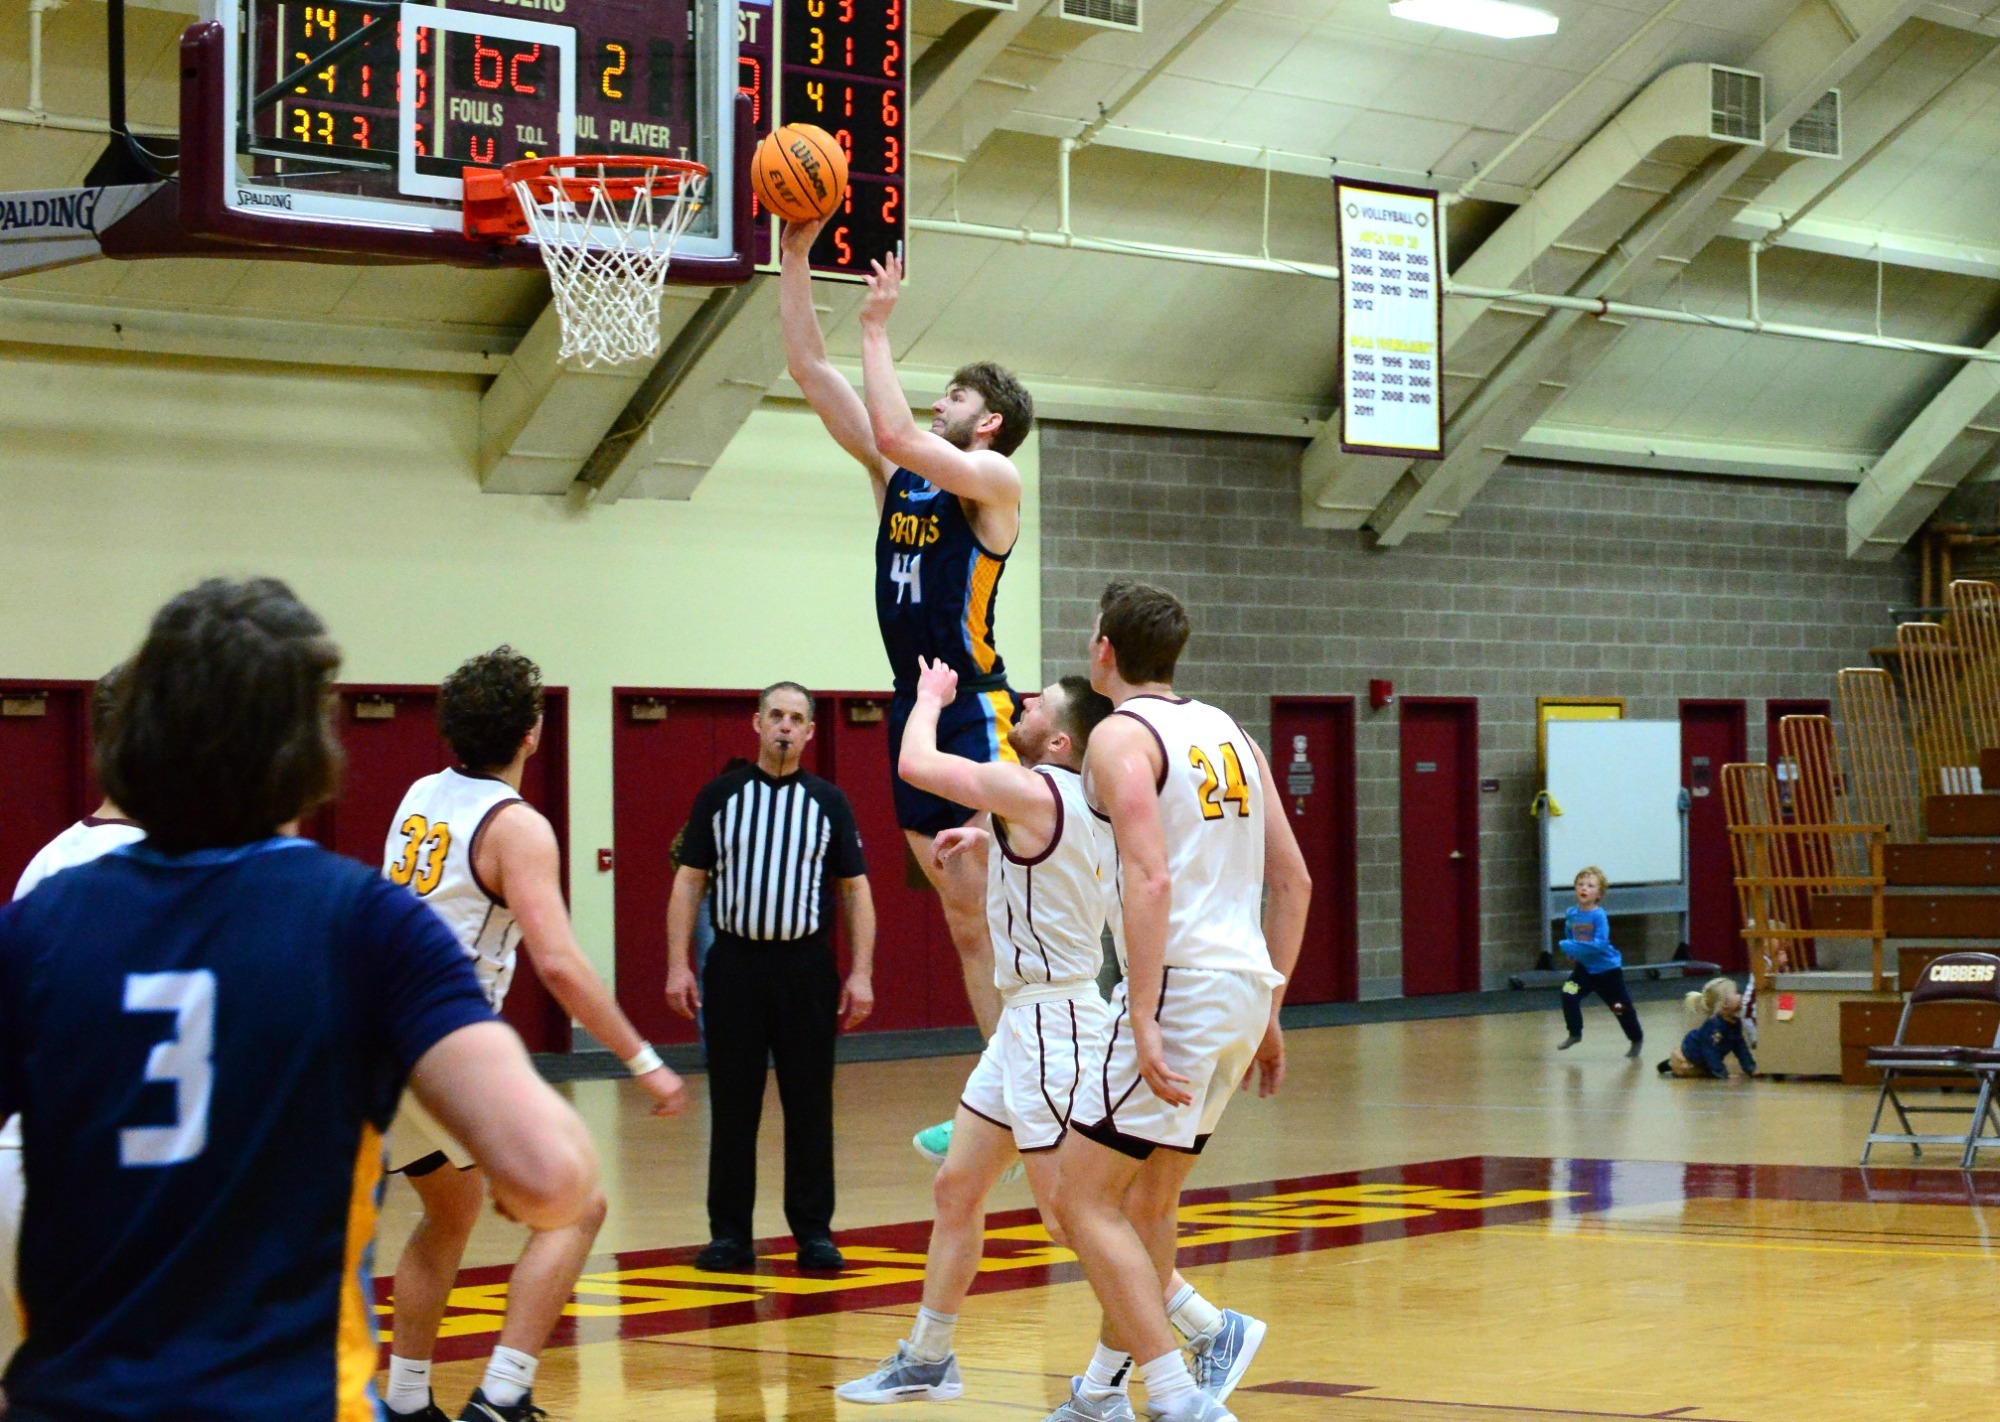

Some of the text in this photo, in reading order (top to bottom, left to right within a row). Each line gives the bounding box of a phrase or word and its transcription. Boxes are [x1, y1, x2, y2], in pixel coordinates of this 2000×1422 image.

[305, 6, 336, 41] 14
[810, 27, 900, 78] 3 1 2
[361, 65, 371, 98] 1
[602, 43, 627, 99] 2
[450, 97, 504, 127] FOULS
[807, 81, 899, 127] 4 1 6
[557, 112, 671, 149] UL PLAYER
[790, 140, 827, 203] Wilson
[884, 136, 899, 173] 3
[0, 190, 97, 231] ALDING
[237, 189, 292, 210] SPALDING
[845, 184, 898, 224] 1 2
[1361, 207, 1414, 225] VOLLEYBALL
[835, 226, 852, 265] 5
[1350, 246, 1429, 266] 2003 2004 2005
[1351, 264, 1430, 283] 2006 2007 2008
[1351, 281, 1429, 300] 2009 2010 2011
[1352, 298, 1374, 311] 2012
[1352, 370, 1431, 388] 2004 2005 2006
[1354, 354, 1431, 371] 1995 1996 2003
[1353, 387, 1431, 405] 2007 2008 2010
[1354, 404, 1374, 417] 2011
[1188, 742, 1250, 821] 24
[390, 814, 452, 897] 33
[1929, 964, 1997, 982] COBBERS
[117, 968, 217, 1168] 3
